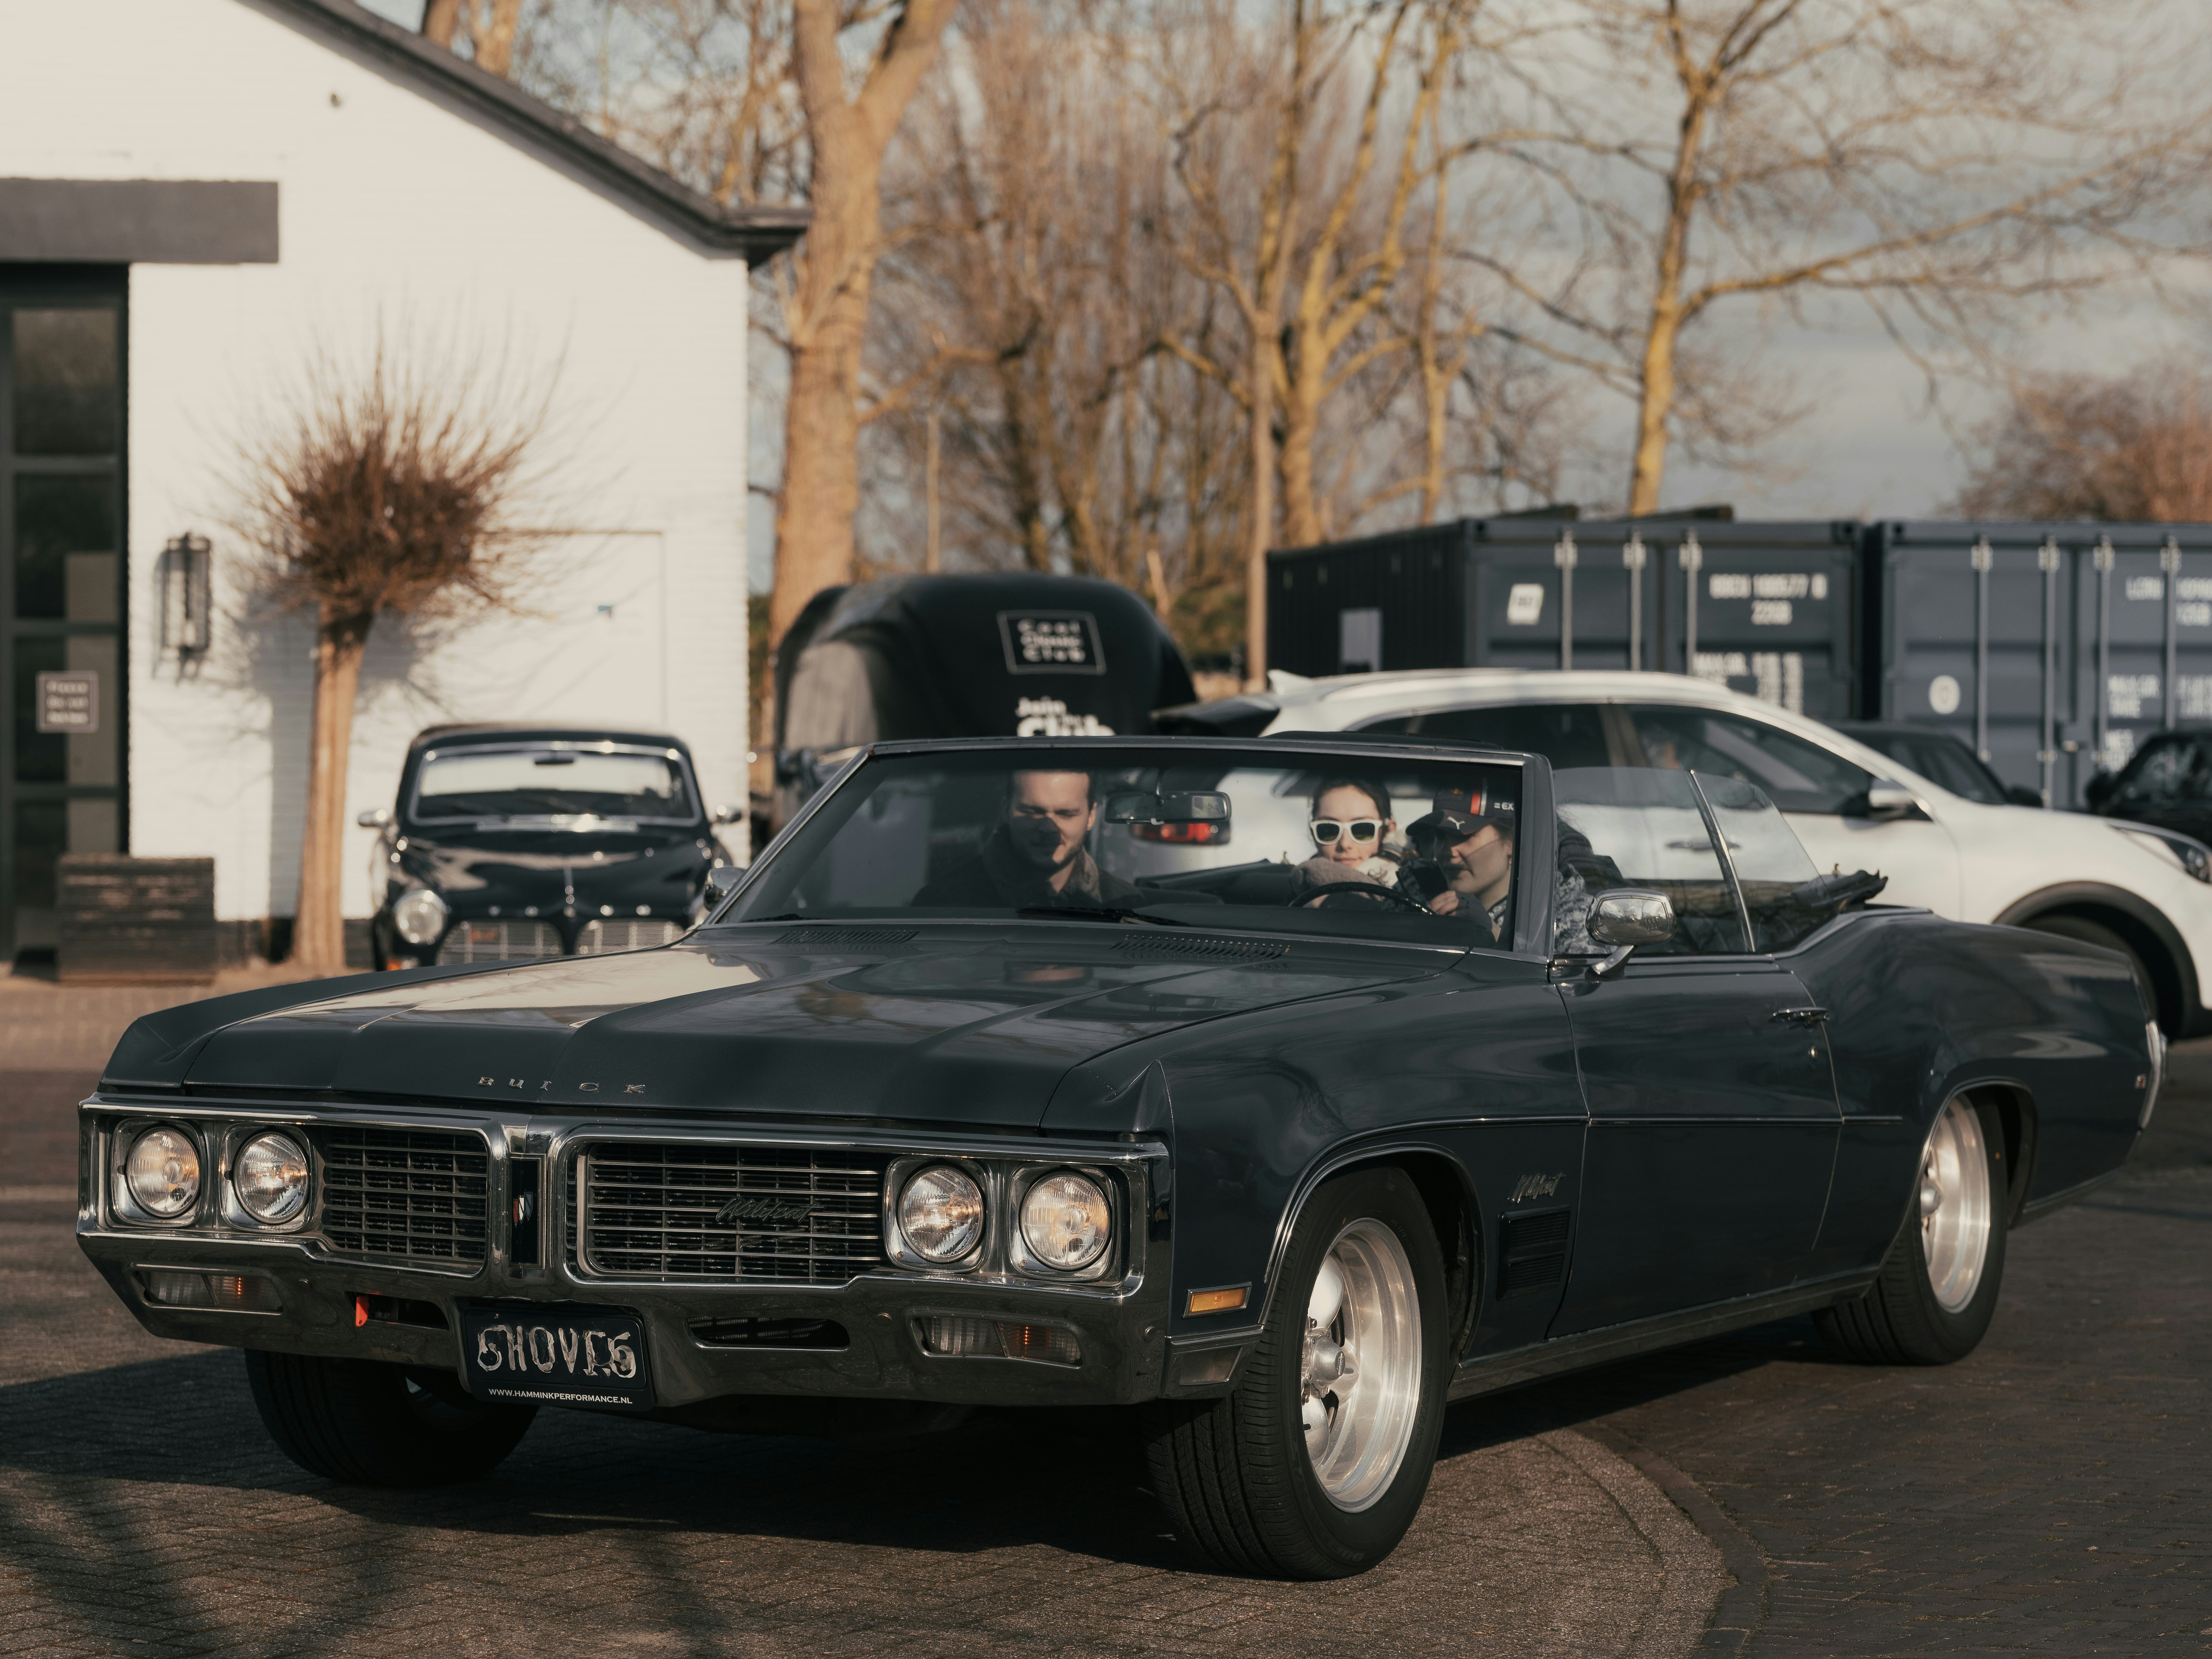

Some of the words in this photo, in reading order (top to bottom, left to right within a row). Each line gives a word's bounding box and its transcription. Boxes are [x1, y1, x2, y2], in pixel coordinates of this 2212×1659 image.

[1017, 619, 1081, 635] Cool
[1023, 646, 1085, 662] Club
[1015, 695, 1067, 718] Join
[477, 1076, 646, 1094] BUICK
[715, 1196, 827, 1223] Wildcat
[488, 1388, 633, 1405] WWW.HAMMINKPERFORMANCE.NL
